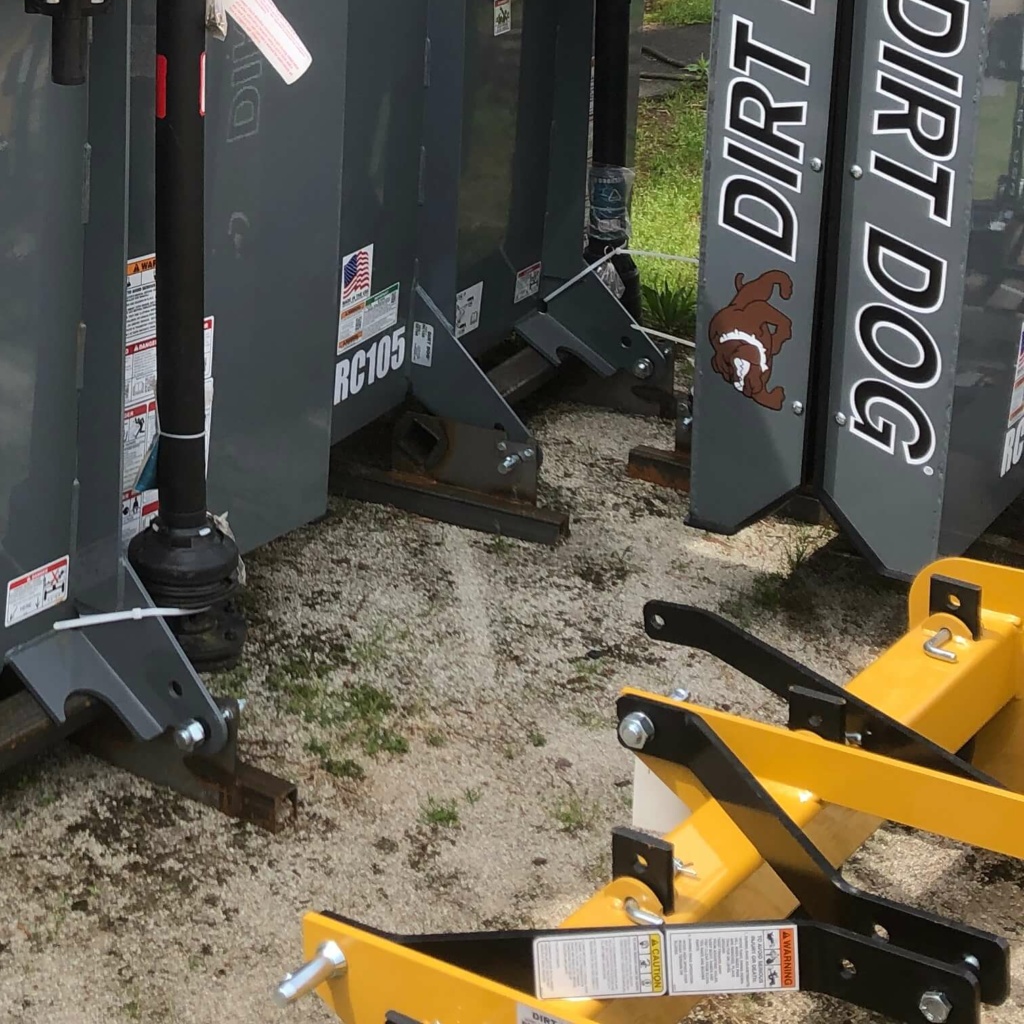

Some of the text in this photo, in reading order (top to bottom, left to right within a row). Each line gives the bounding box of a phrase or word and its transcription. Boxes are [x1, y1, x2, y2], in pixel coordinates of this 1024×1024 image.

[718, 14, 810, 262] DIRT
[334, 326, 406, 406] RC105
[849, 221, 948, 466] DOG
[652, 948, 663, 988] CAUTION
[782, 939, 793, 986] WARNING
